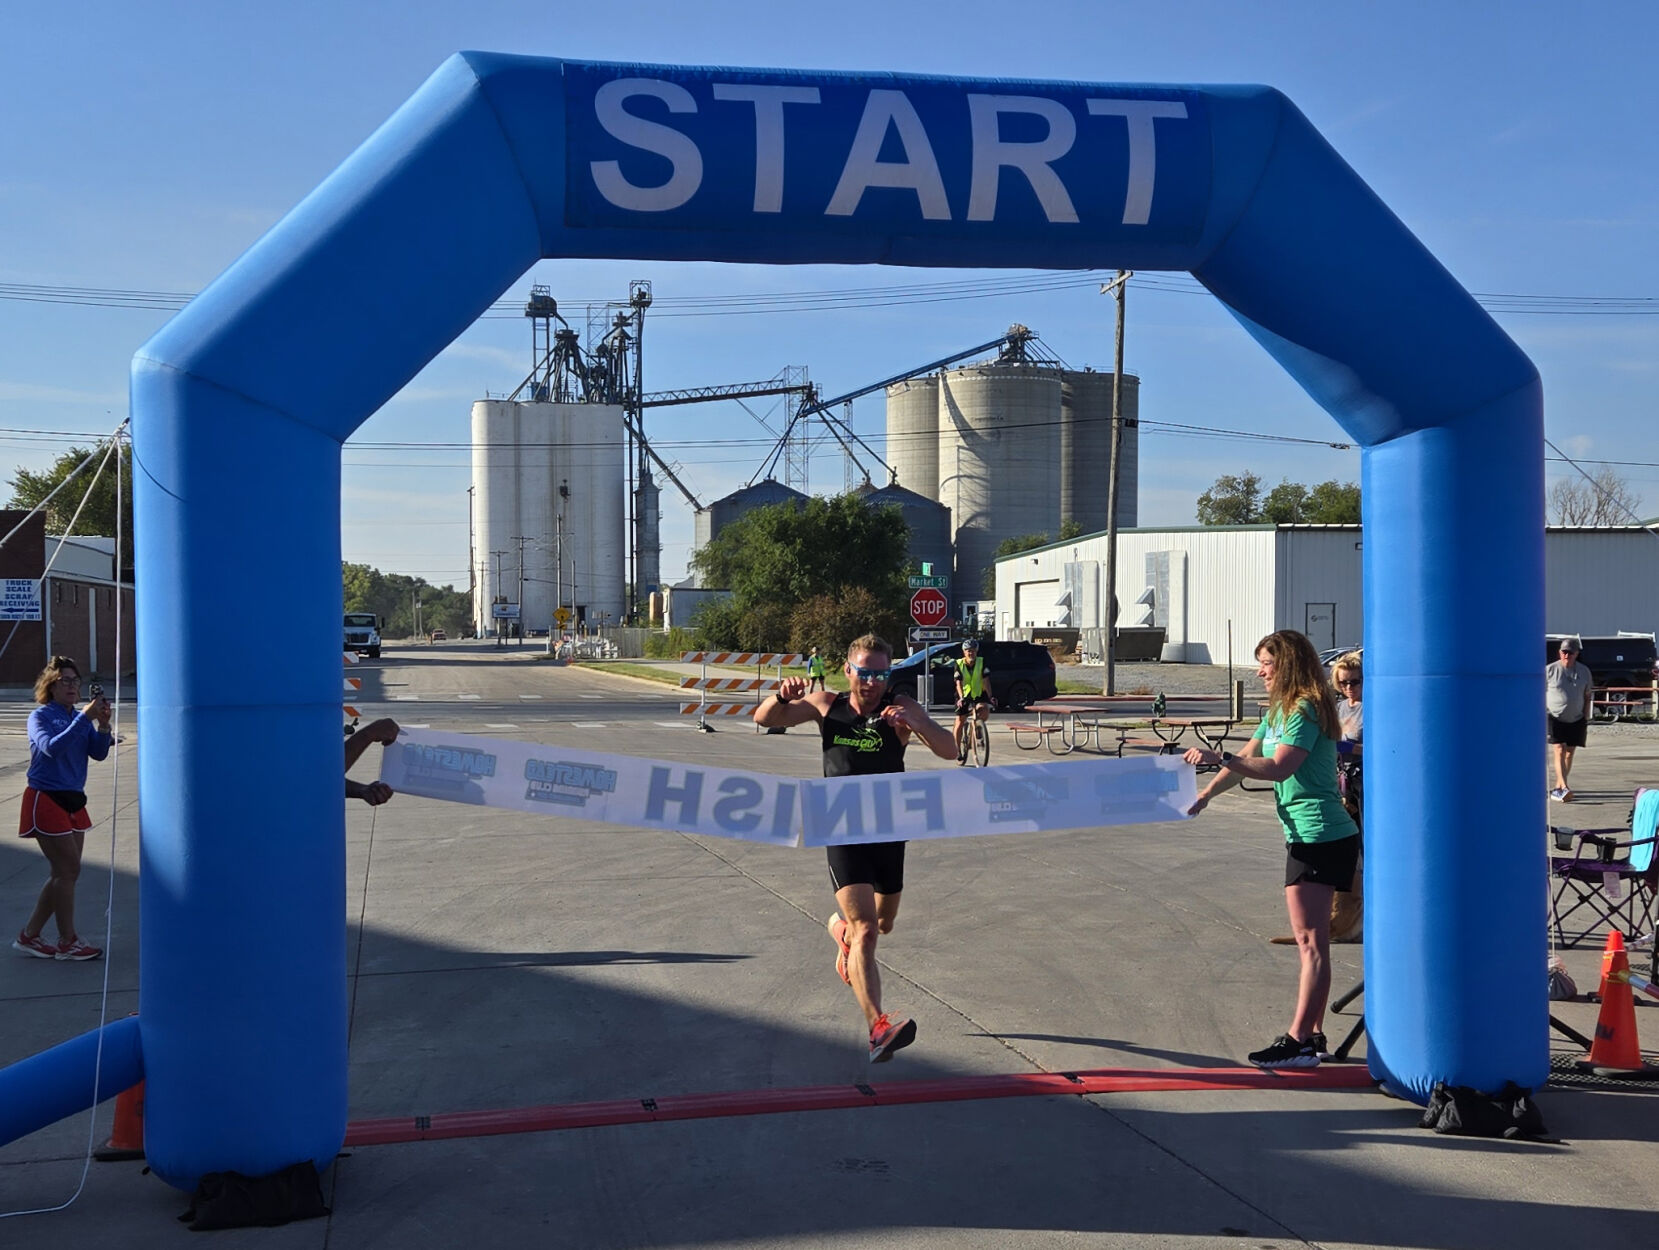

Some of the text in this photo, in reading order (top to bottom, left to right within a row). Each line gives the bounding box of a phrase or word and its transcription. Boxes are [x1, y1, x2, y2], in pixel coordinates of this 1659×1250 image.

[590, 77, 1189, 225] START
[911, 577, 946, 587] Market St
[913, 600, 945, 615] STOP
